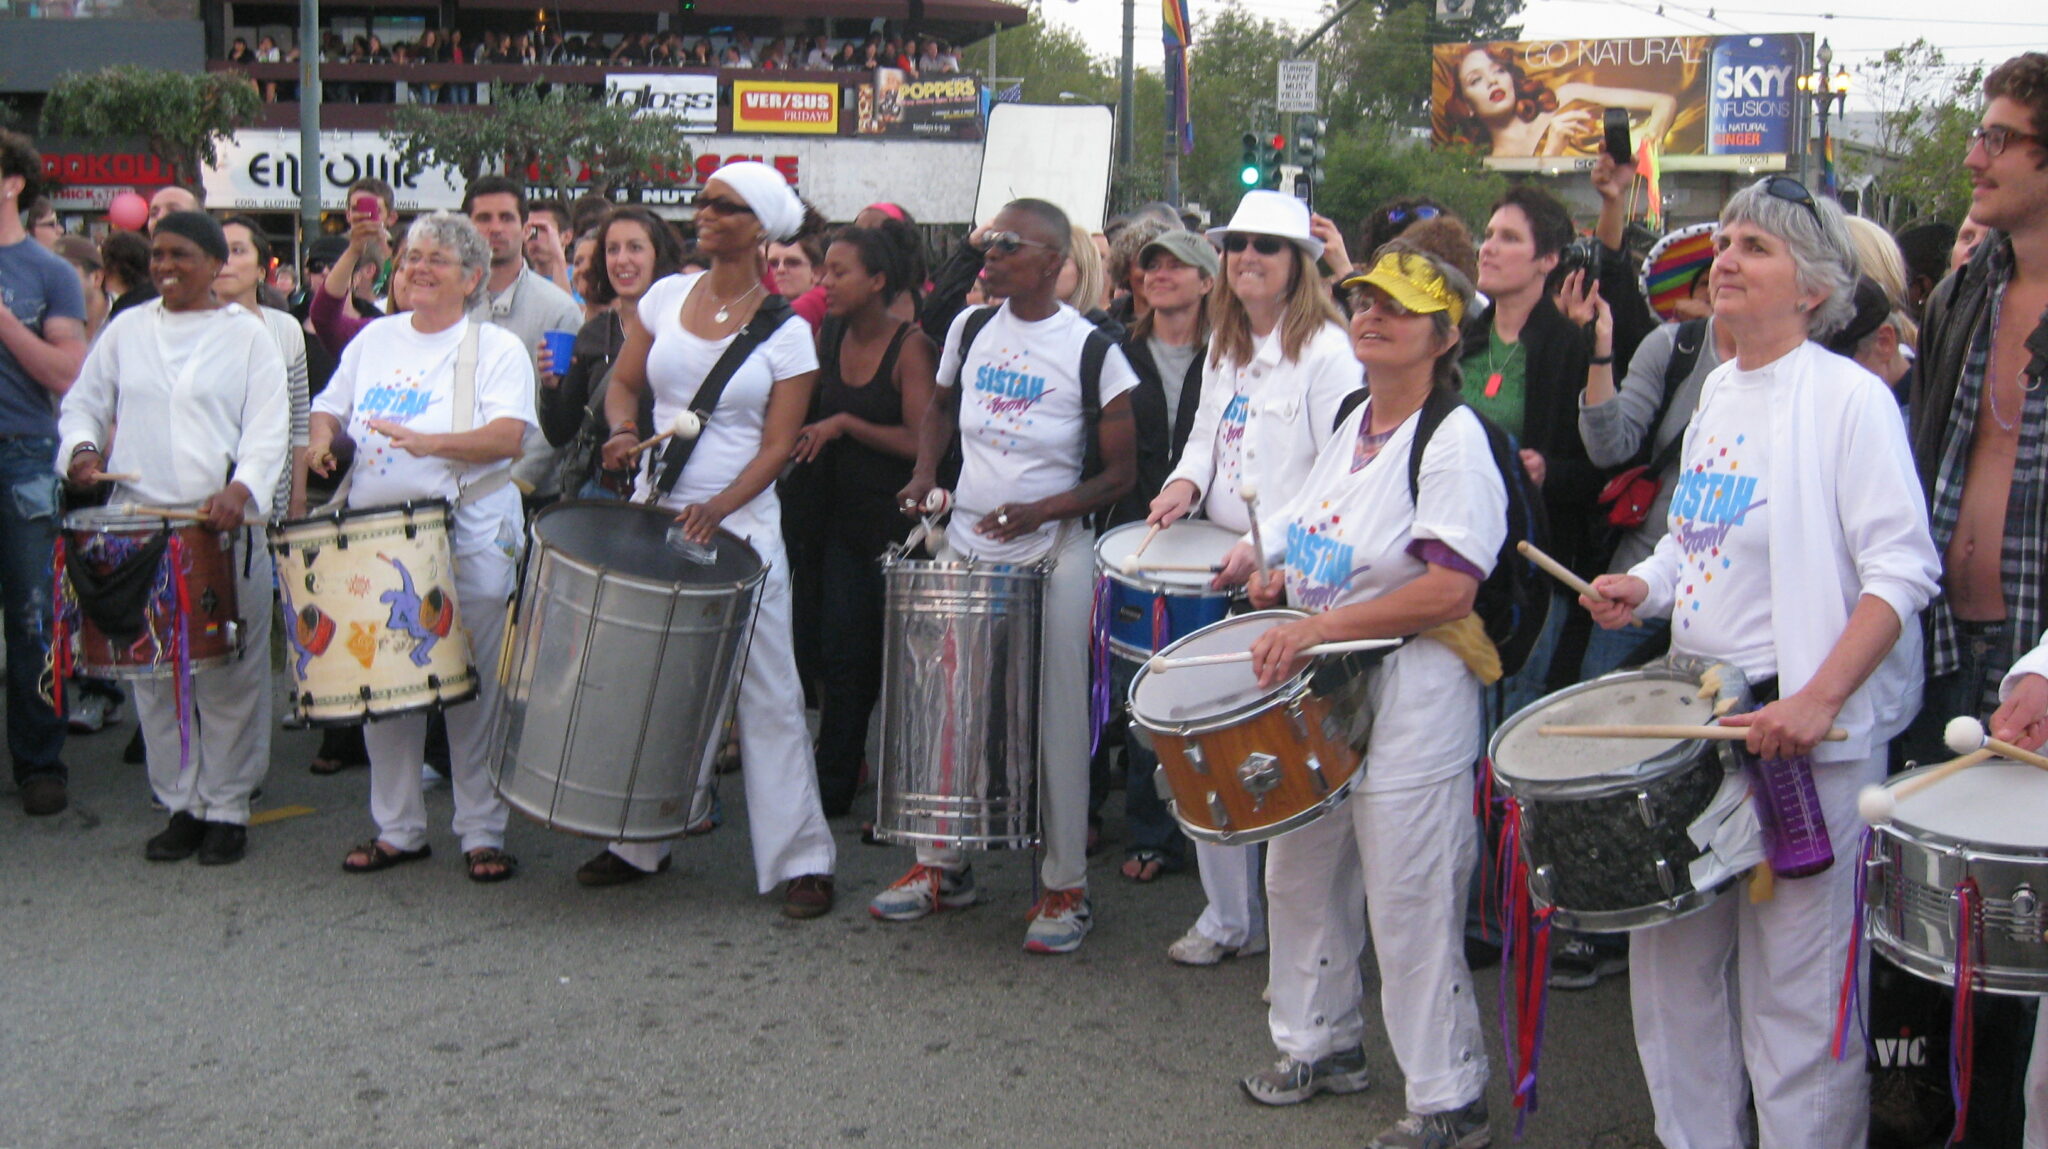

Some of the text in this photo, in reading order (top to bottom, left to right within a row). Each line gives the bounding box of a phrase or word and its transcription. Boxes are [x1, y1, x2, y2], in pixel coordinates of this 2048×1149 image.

[1525, 37, 1702, 68] GO NATURAL
[1282, 64, 1313, 72] TURNING
[1283, 73, 1311, 81] TRAFFIC
[1715, 64, 1793, 99] SKYY
[899, 80, 976, 100] POPPERS
[1285, 82, 1309, 90] MUST
[746, 93, 829, 109] VER/SUS
[1280, 91, 1302, 99] YIELD
[783, 110, 829, 121] FRIDAYS
[1714, 133, 1761, 146] GINGER
[263, 199, 301, 208] CLOTHIN
[975, 365, 1045, 403] SISTAH
[1285, 522, 1354, 591] SISTAH
